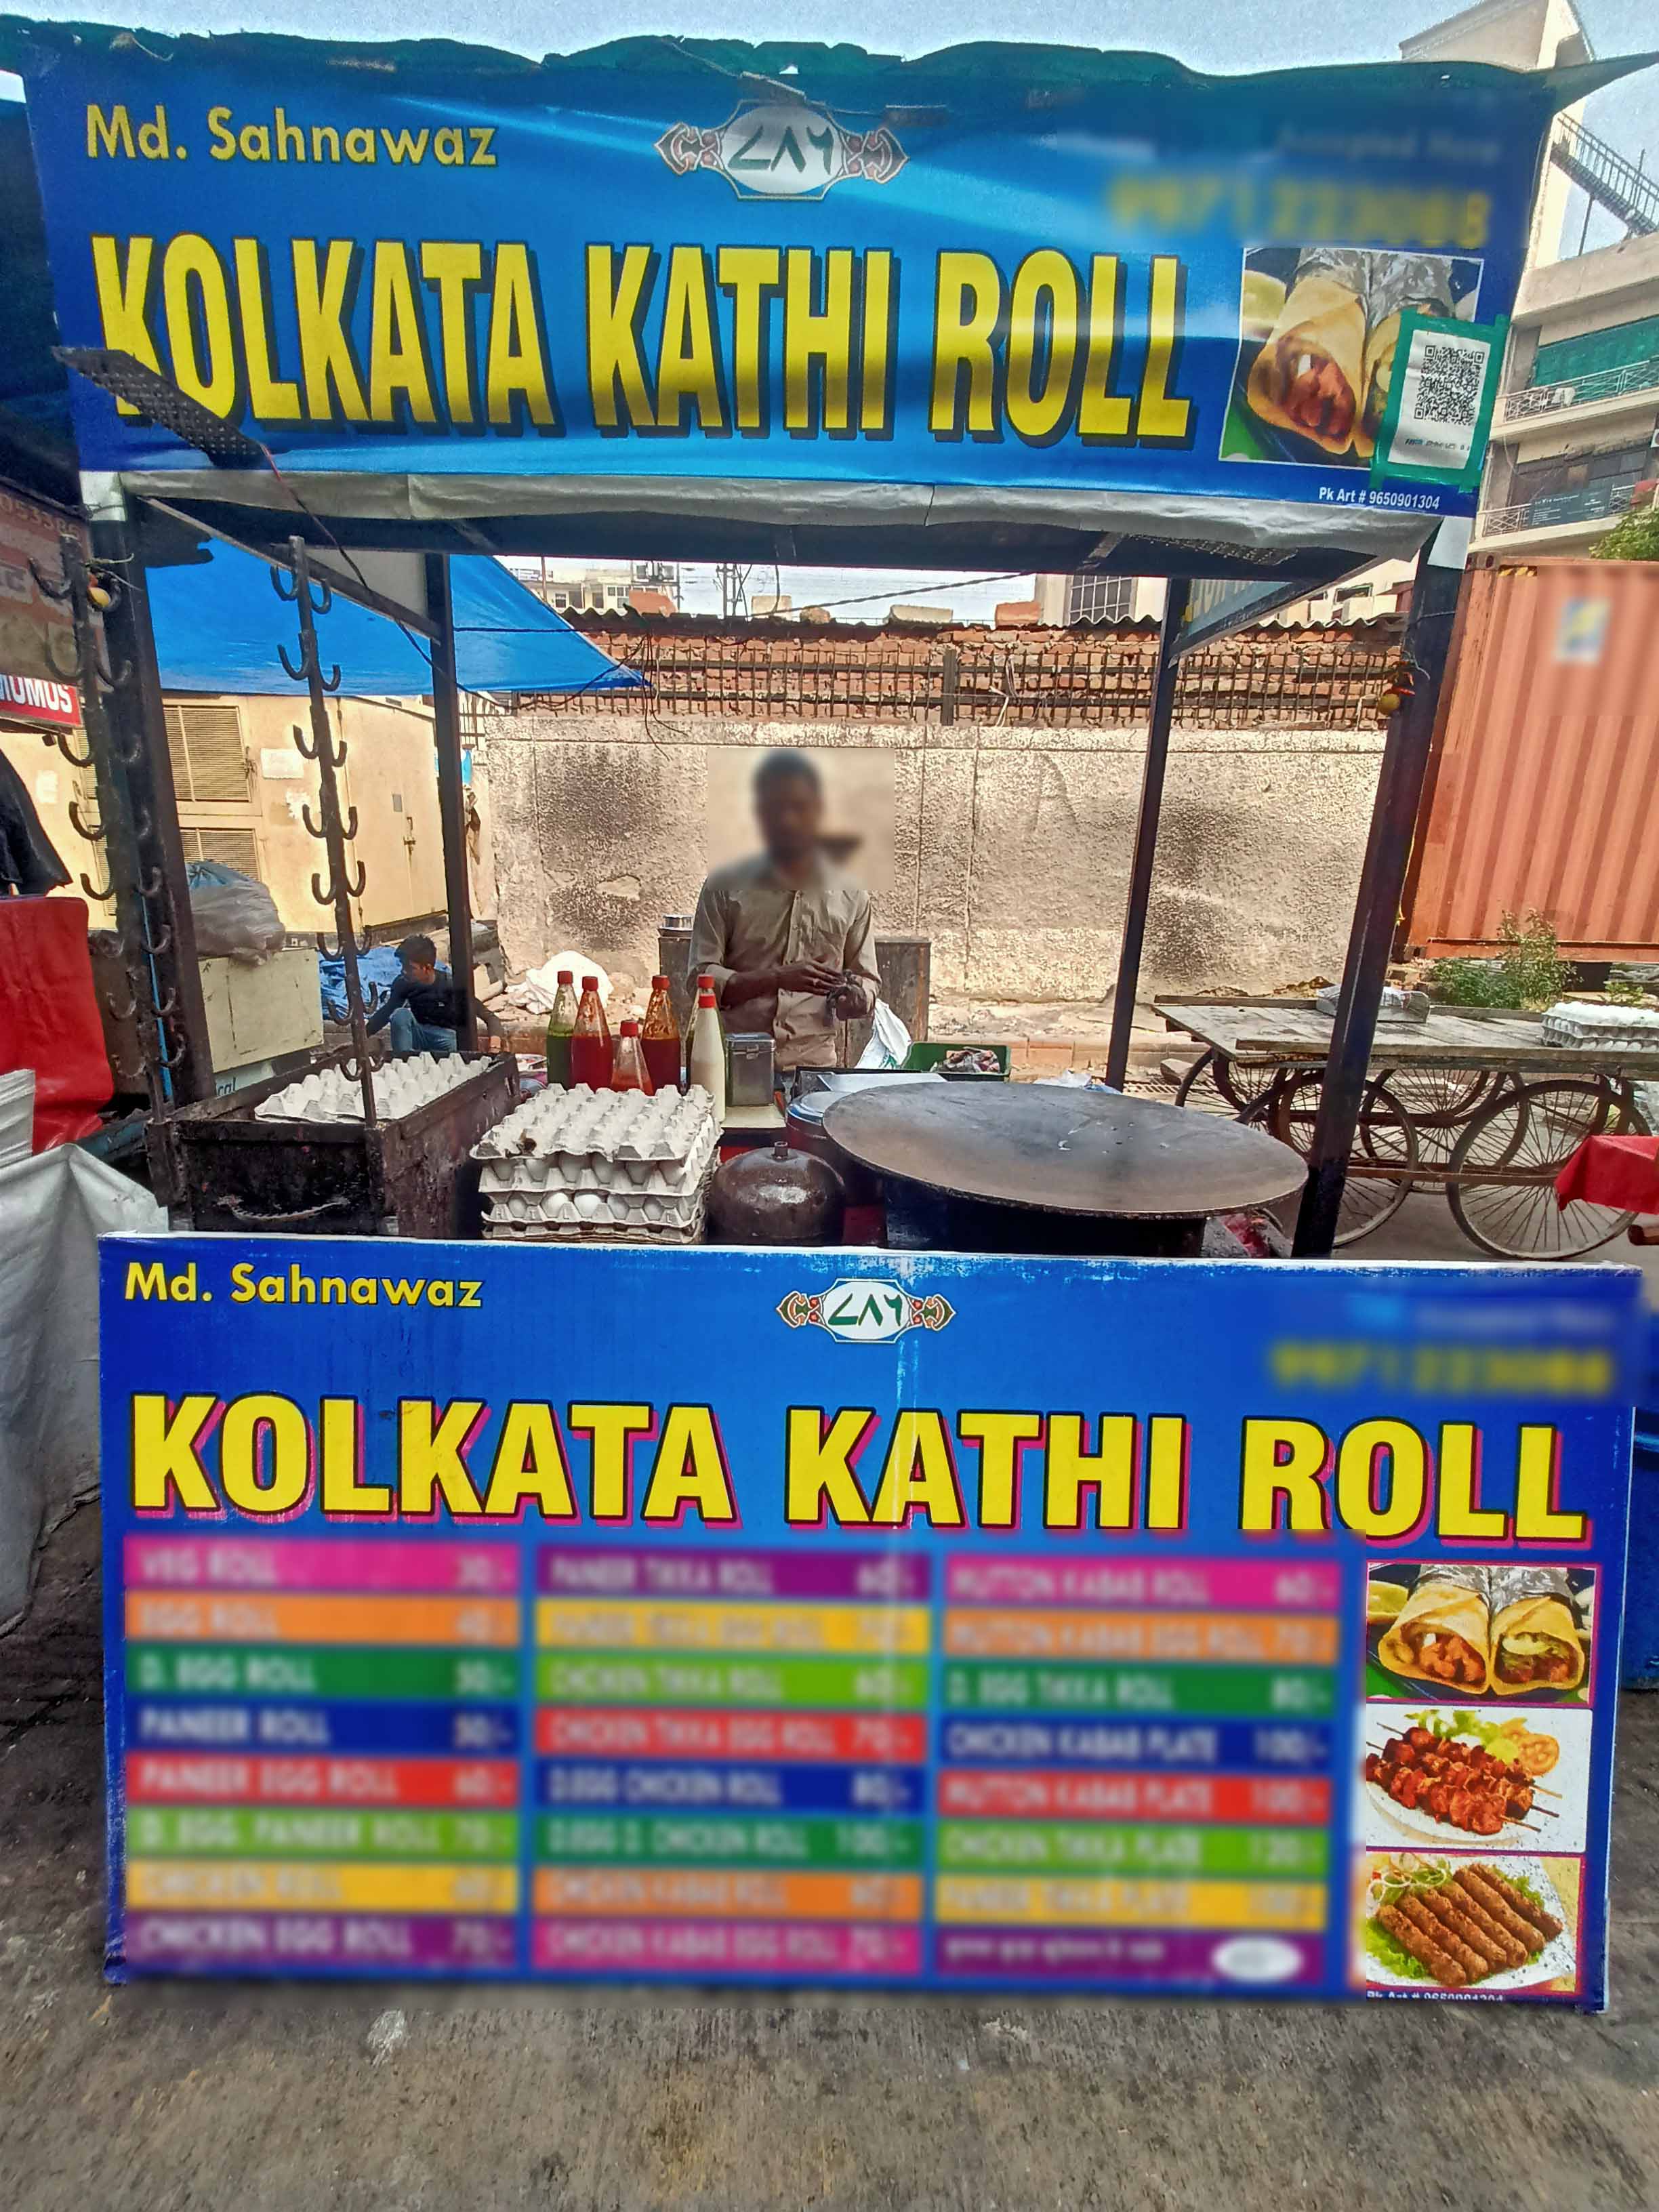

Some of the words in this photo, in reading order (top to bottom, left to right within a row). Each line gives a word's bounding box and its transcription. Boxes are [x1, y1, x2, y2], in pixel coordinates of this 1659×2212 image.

[87, 104, 186, 161] Md.
[208, 104, 499, 167] Sahnawaz
[90, 232, 558, 430] KOLKATA
[585, 243, 895, 436] KATHI
[928, 247, 1191, 442] ROLL
[1318, 487, 1334, 501] Pk
[1336, 489, 1356, 503] Art
[1369, 490, 1441, 510] 9650901304
[125, 1263, 213, 1303] Md.
[230, 1263, 485, 1309] Sahnawaz
[131, 1390, 739, 1525] KOLKATA
[784, 1405, 1188, 1531] KATHI
[1238, 1415, 1591, 1546] ROLL
